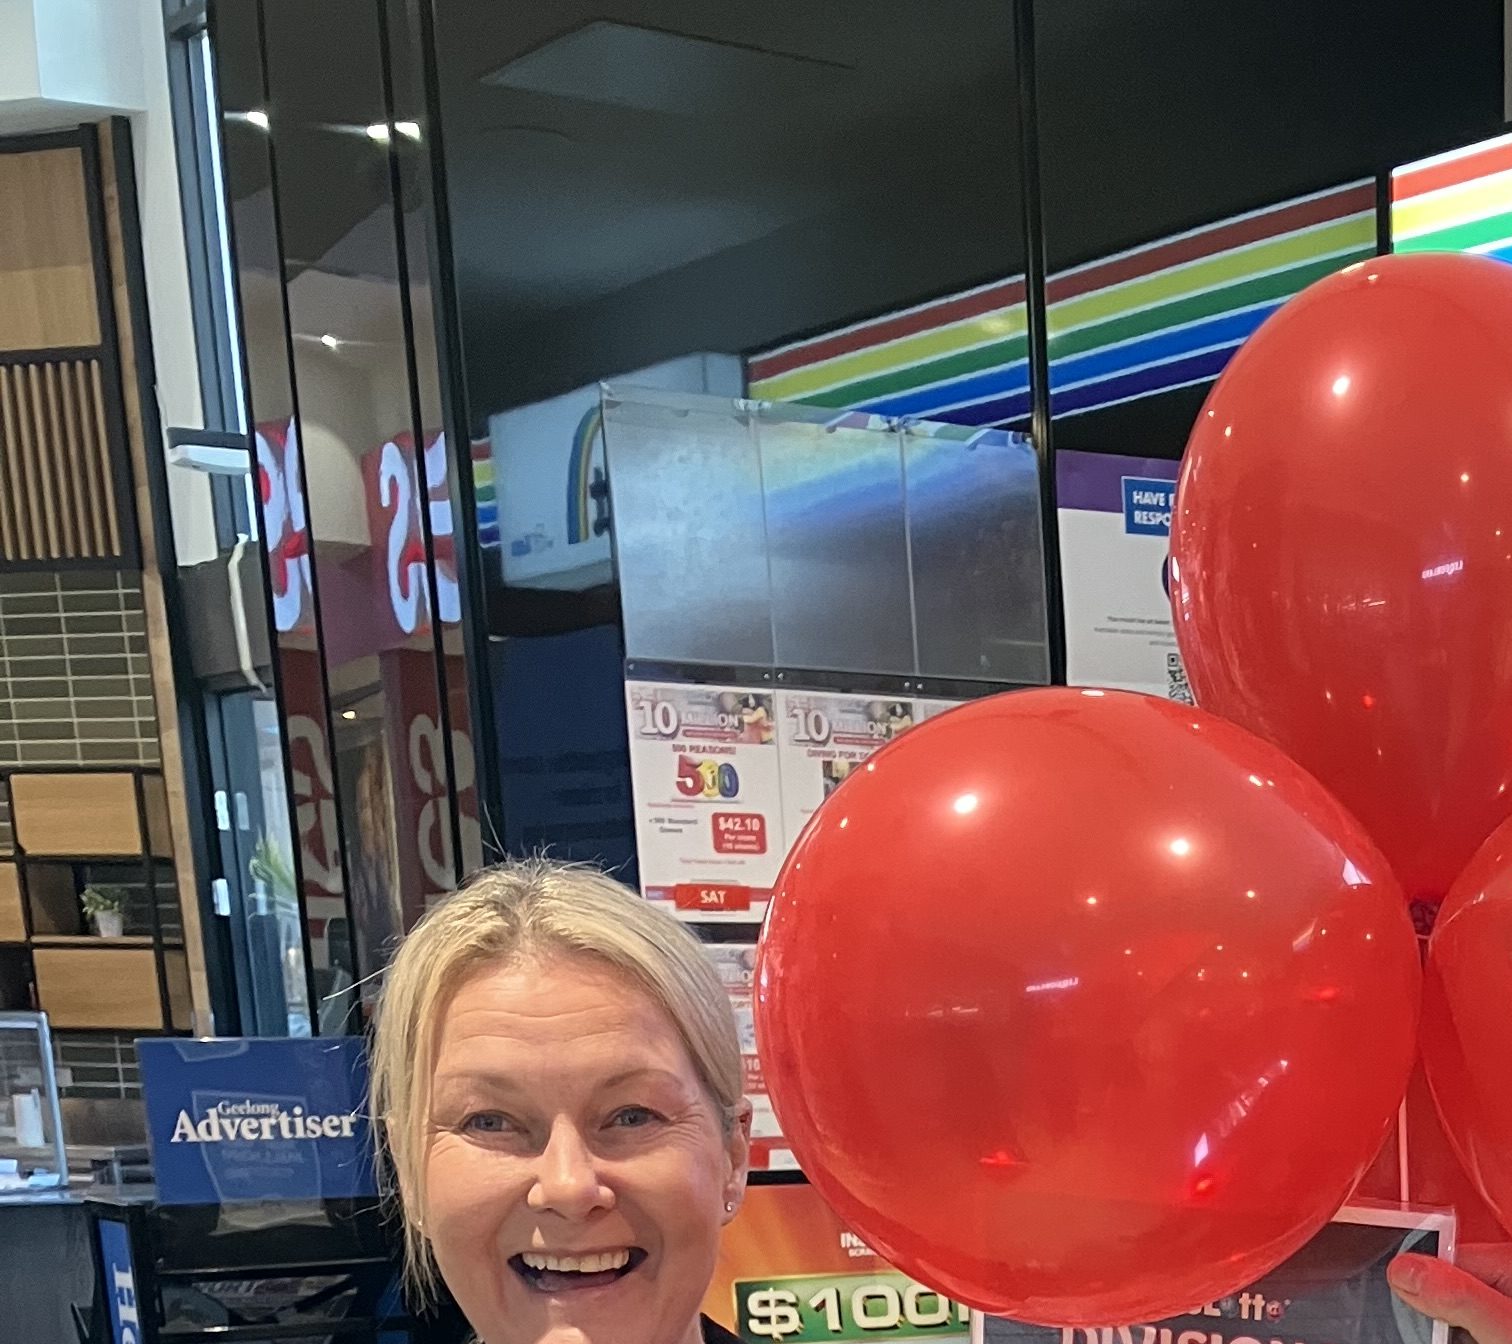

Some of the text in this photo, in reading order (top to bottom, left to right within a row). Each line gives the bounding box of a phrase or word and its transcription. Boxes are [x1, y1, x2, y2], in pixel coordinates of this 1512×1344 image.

[1133, 491, 1160, 506] HAVE
[640, 700, 679, 736] 10
[792, 709, 830, 742] 10
[676, 755, 739, 798] 500
[700, 890, 727, 904] SAT
[171, 1106, 357, 1144] Advertiser
[217, 1100, 279, 1119] Geelong
